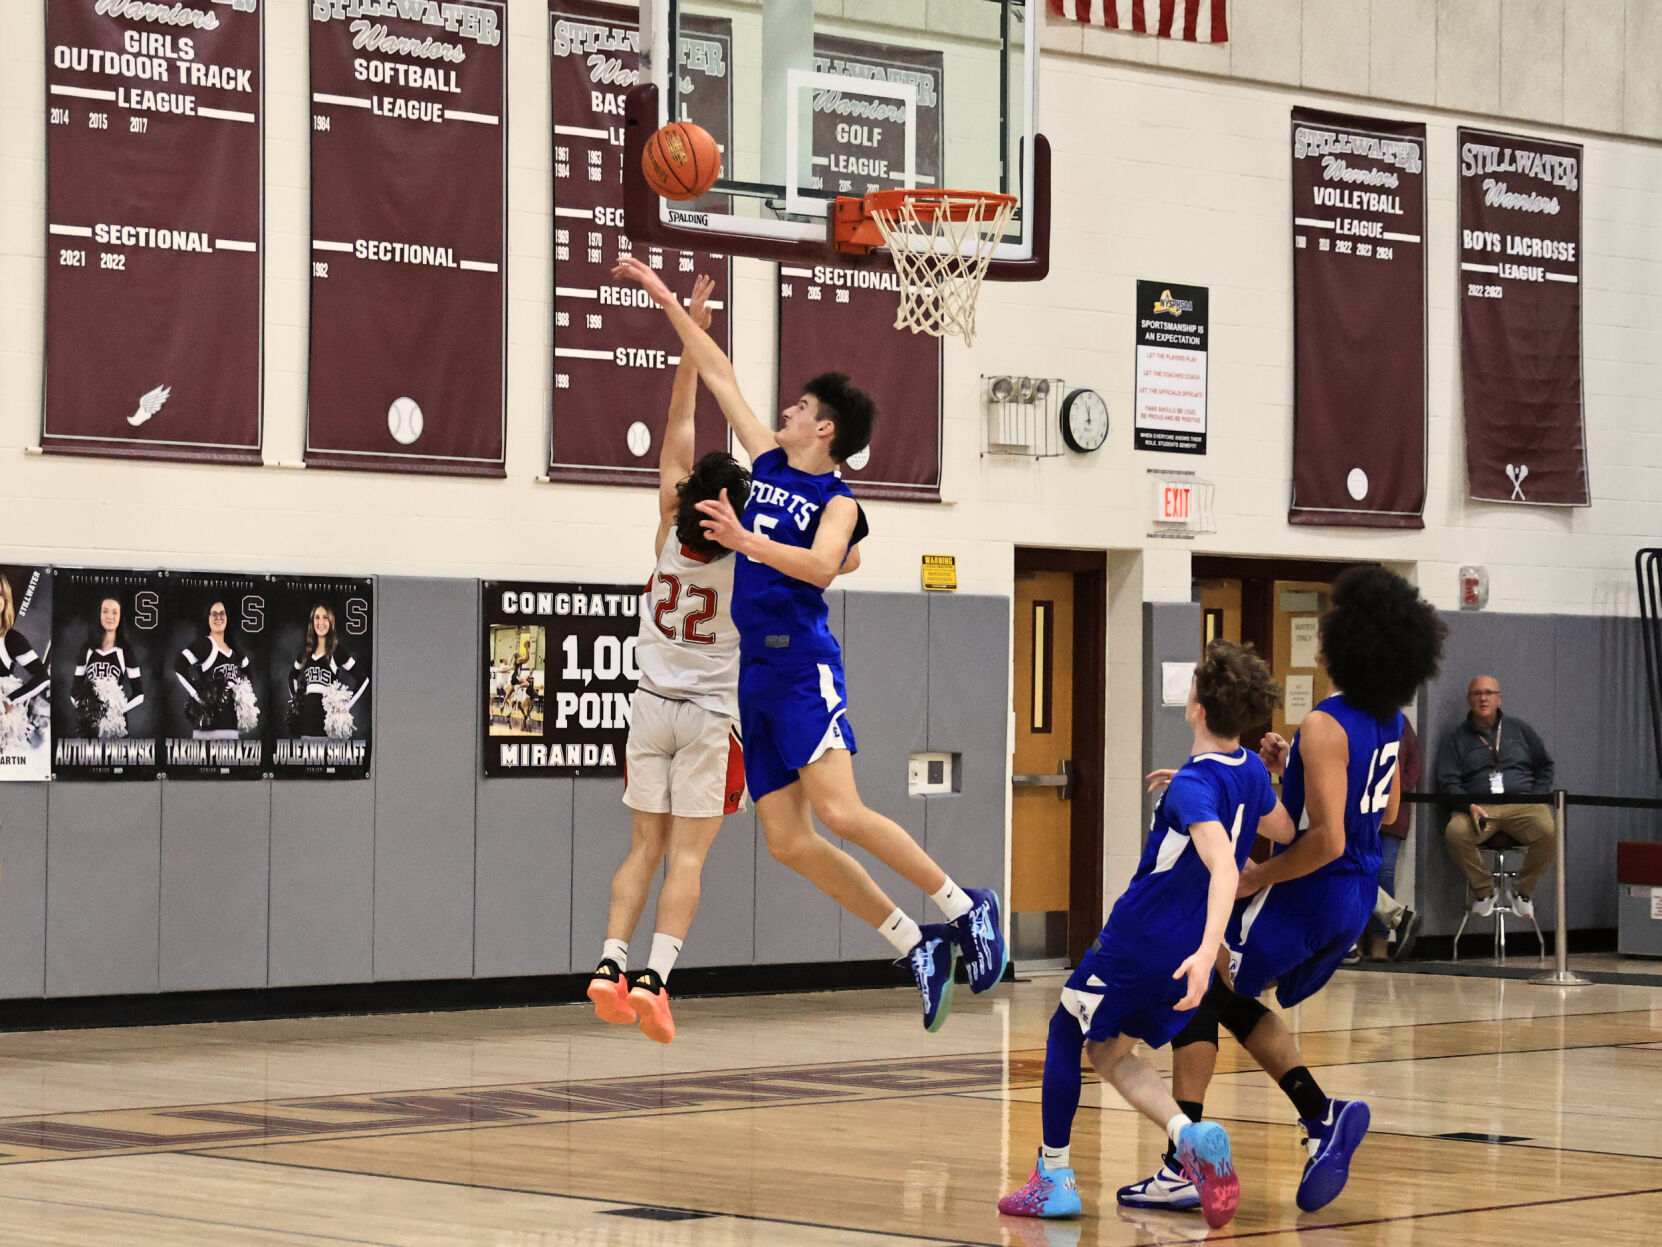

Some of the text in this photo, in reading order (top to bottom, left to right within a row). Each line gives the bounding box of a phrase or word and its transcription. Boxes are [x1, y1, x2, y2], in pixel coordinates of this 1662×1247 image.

[124, 30, 195, 60] GIRLS
[350, 19, 466, 63] Warriors
[54, 46, 253, 92] OUTDOOR TRACK
[354, 58, 461, 93] SOFTBALL
[118, 87, 195, 116] LEAGUE
[372, 96, 442, 123] LEAGUE
[50, 108, 148, 134] 2014 2015 2017
[837, 124, 882, 148] GOLF
[1295, 127, 1422, 174] STILLWATER
[830, 154, 888, 178] LEAGUE
[1322, 156, 1398, 188] Warriors
[1462, 142, 1578, 192] STILLWATER
[1313, 186, 1404, 214] VOLLEYBALL
[1482, 178, 1560, 215] Warriors
[668, 210, 708, 227] SPALDING
[1336, 218, 1384, 238] LEAGUE
[95, 223, 213, 253] SECTIONAL
[1336, 240, 1352, 254] 2022
[1463, 230, 1576, 262] BOYS LACROSSE
[60, 250, 126, 270] 2021 2022
[355, 239, 457, 268] SECTIONAL
[814, 266, 900, 292] SECTIONAL
[1500, 263, 1544, 282] LEAGUE
[1141, 320, 1204, 334] SPORTSMANSHIP IS
[1145, 332, 1200, 345] AN EXPECTATION
[616, 347, 665, 369] STATE
[744, 479, 819, 531] FORTS
[1165, 488, 1190, 518] EXIT
[19, 571, 40, 617] STILLWATER
[502, 591, 641, 617] CONGRATU
[655, 572, 718, 644] 22
[135, 591, 158, 629] S
[241, 595, 265, 633] S
[346, 598, 368, 634] S
[55, 738, 102, 765] AUTUMN
[500, 744, 616, 768] MIRANDA
[1360, 741, 1400, 814] 12
